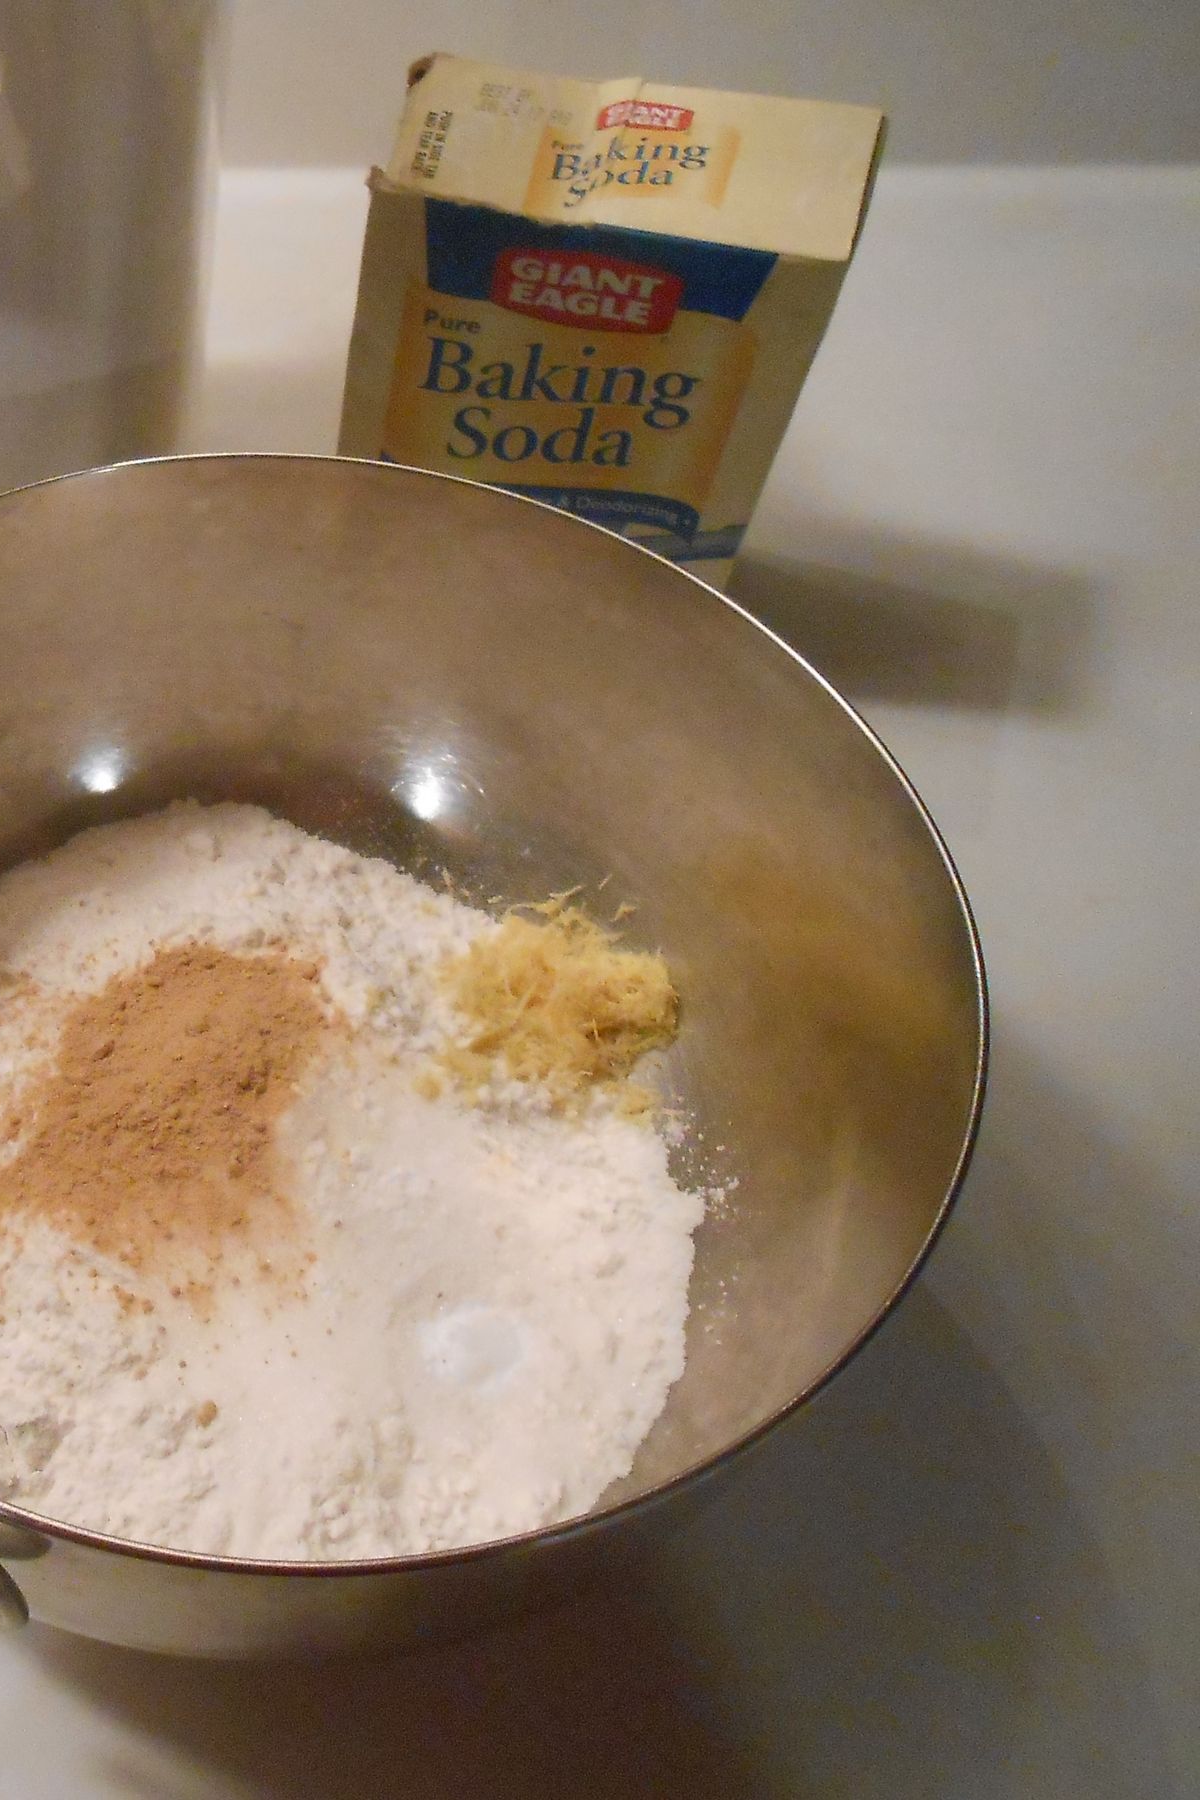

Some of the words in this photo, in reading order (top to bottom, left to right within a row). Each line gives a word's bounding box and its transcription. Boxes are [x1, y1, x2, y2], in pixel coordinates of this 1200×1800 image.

[509, 257, 666, 298] GIANT
[424, 309, 482, 335] Pure
[507, 282, 652, 325] EAGLE
[417, 335, 702, 430] Baking
[446, 405, 633, 468] Soda
